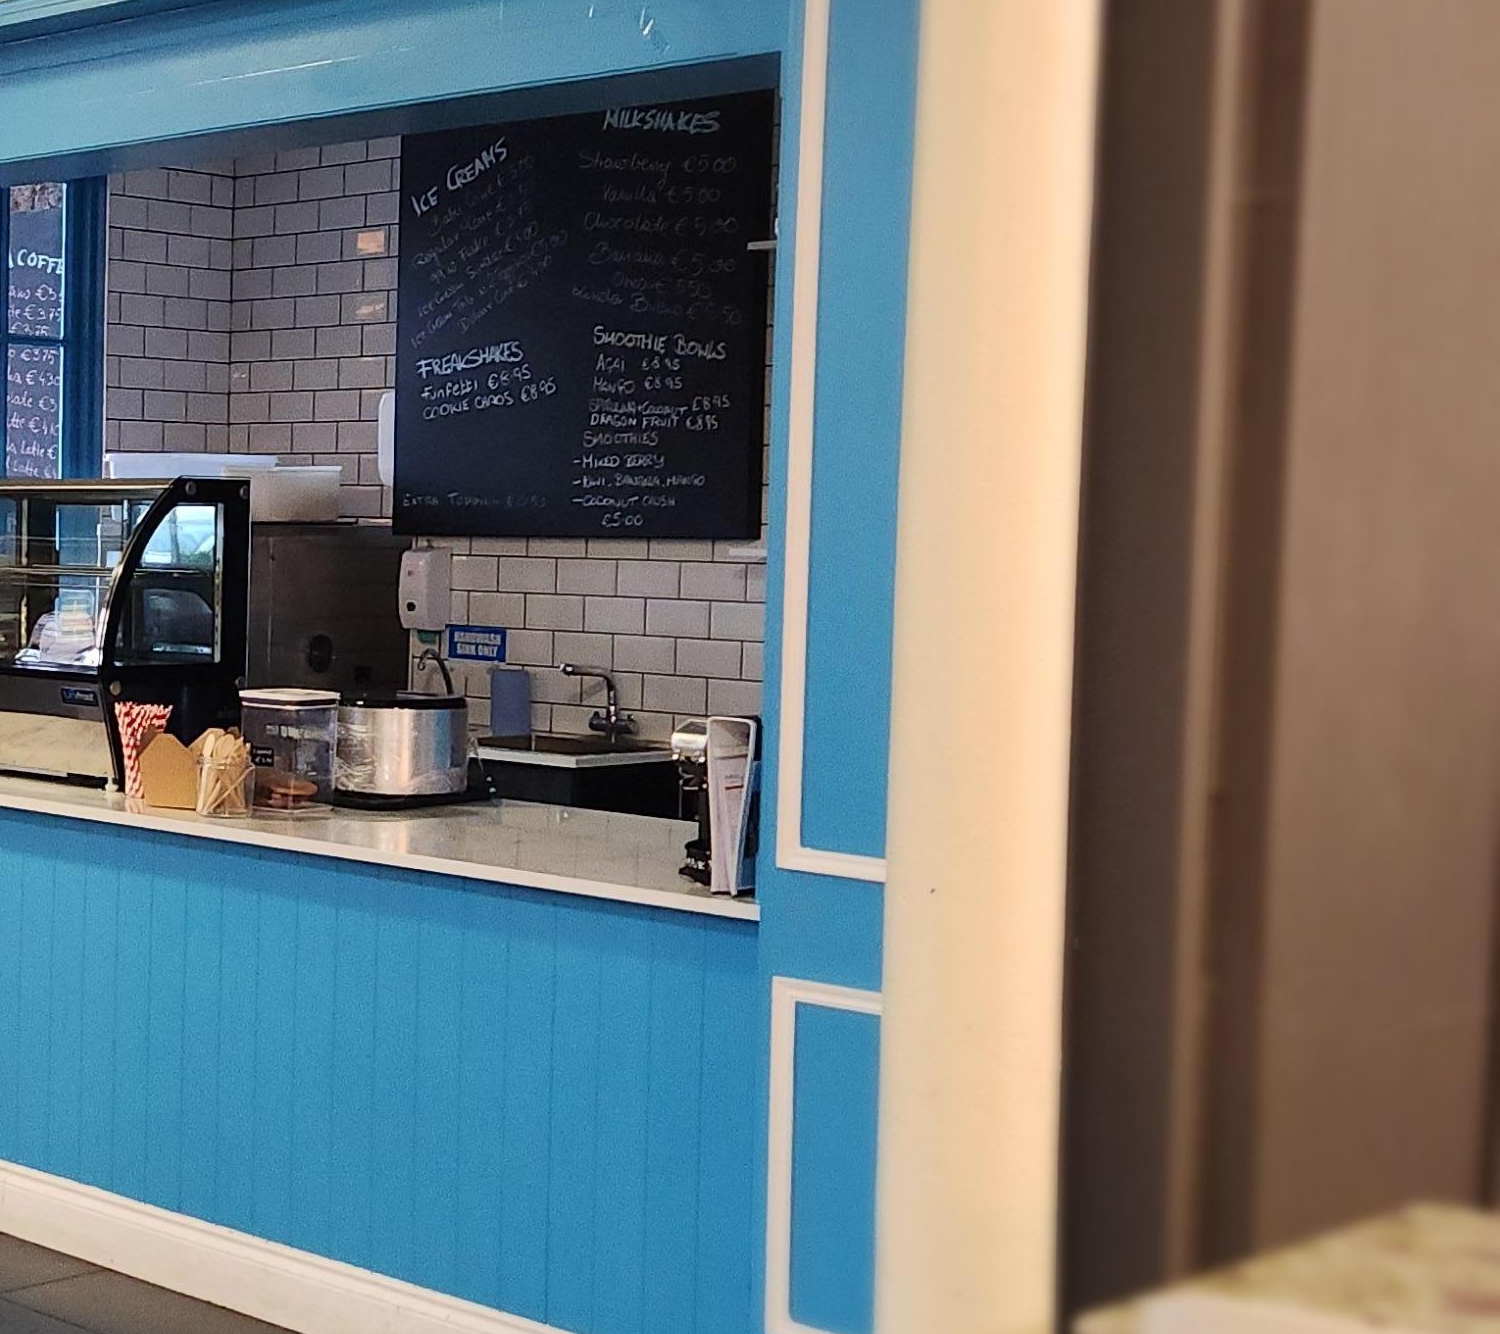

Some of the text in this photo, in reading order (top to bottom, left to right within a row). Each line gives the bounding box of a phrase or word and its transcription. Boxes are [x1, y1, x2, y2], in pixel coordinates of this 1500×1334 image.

[602, 107, 722, 135] MILKSHAKES
[411, 136, 508, 218] ICE CREAMS
[593, 325, 727, 360] SMOOTHIE BOWLS
[590, 413, 638, 427] DRAGON
[641, 414, 681, 430] FRUIT
[582, 430, 660, 448] SMOOTHIES
